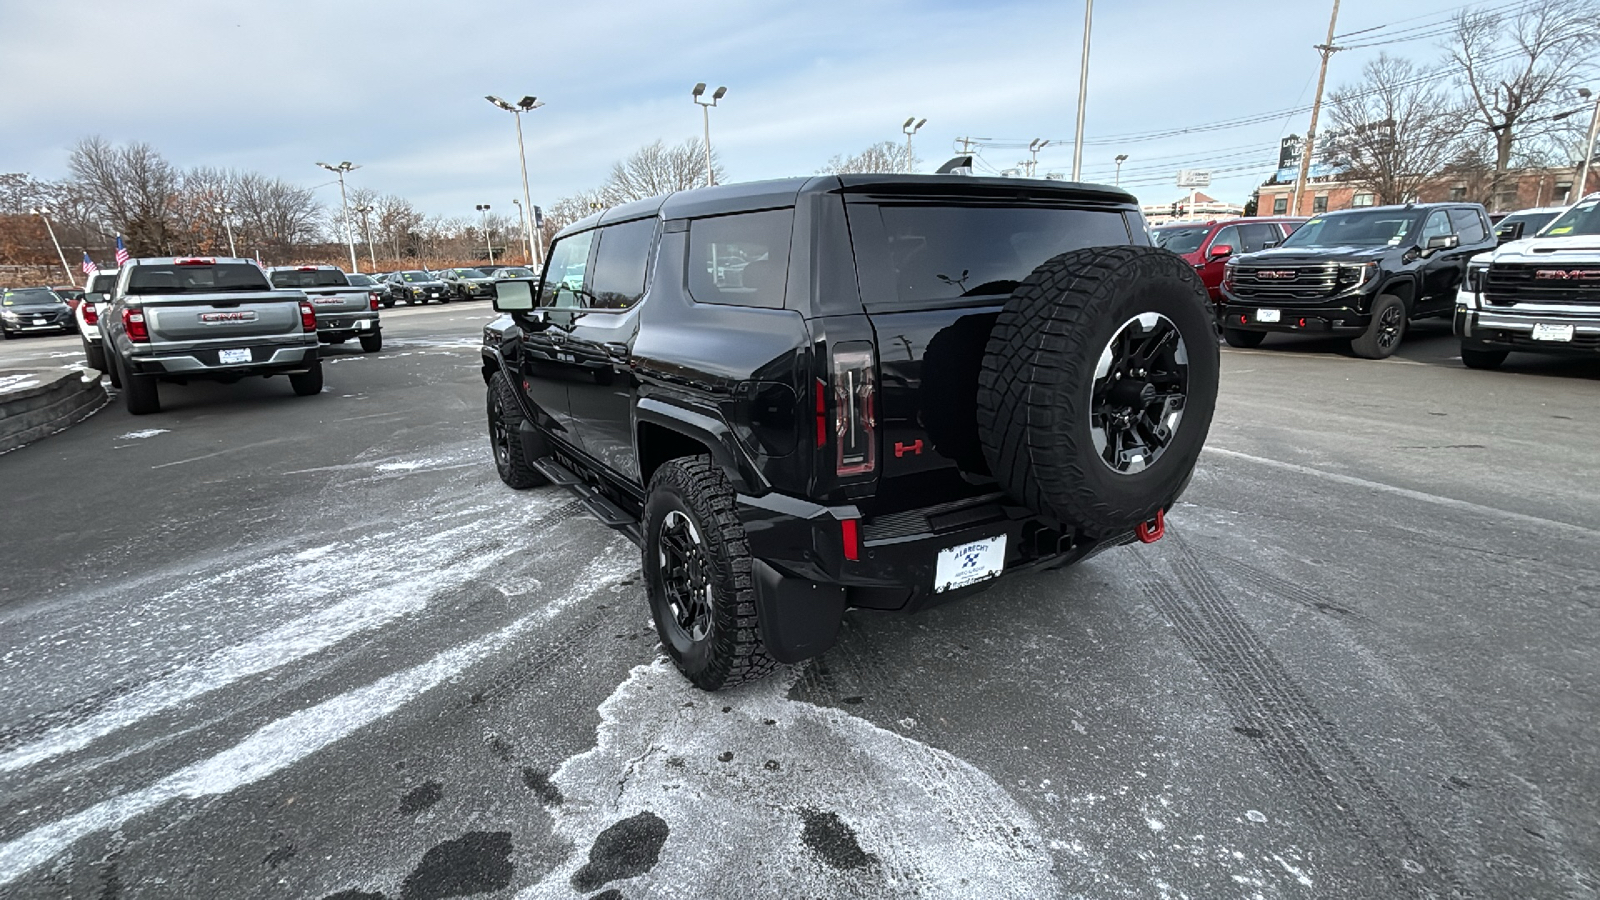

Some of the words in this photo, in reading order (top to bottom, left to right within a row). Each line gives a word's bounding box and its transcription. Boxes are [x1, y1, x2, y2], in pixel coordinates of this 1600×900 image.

[1535, 270, 1600, 280] GMC
[895, 439, 924, 458] H
[954, 544, 989, 560] ALBRECHT
